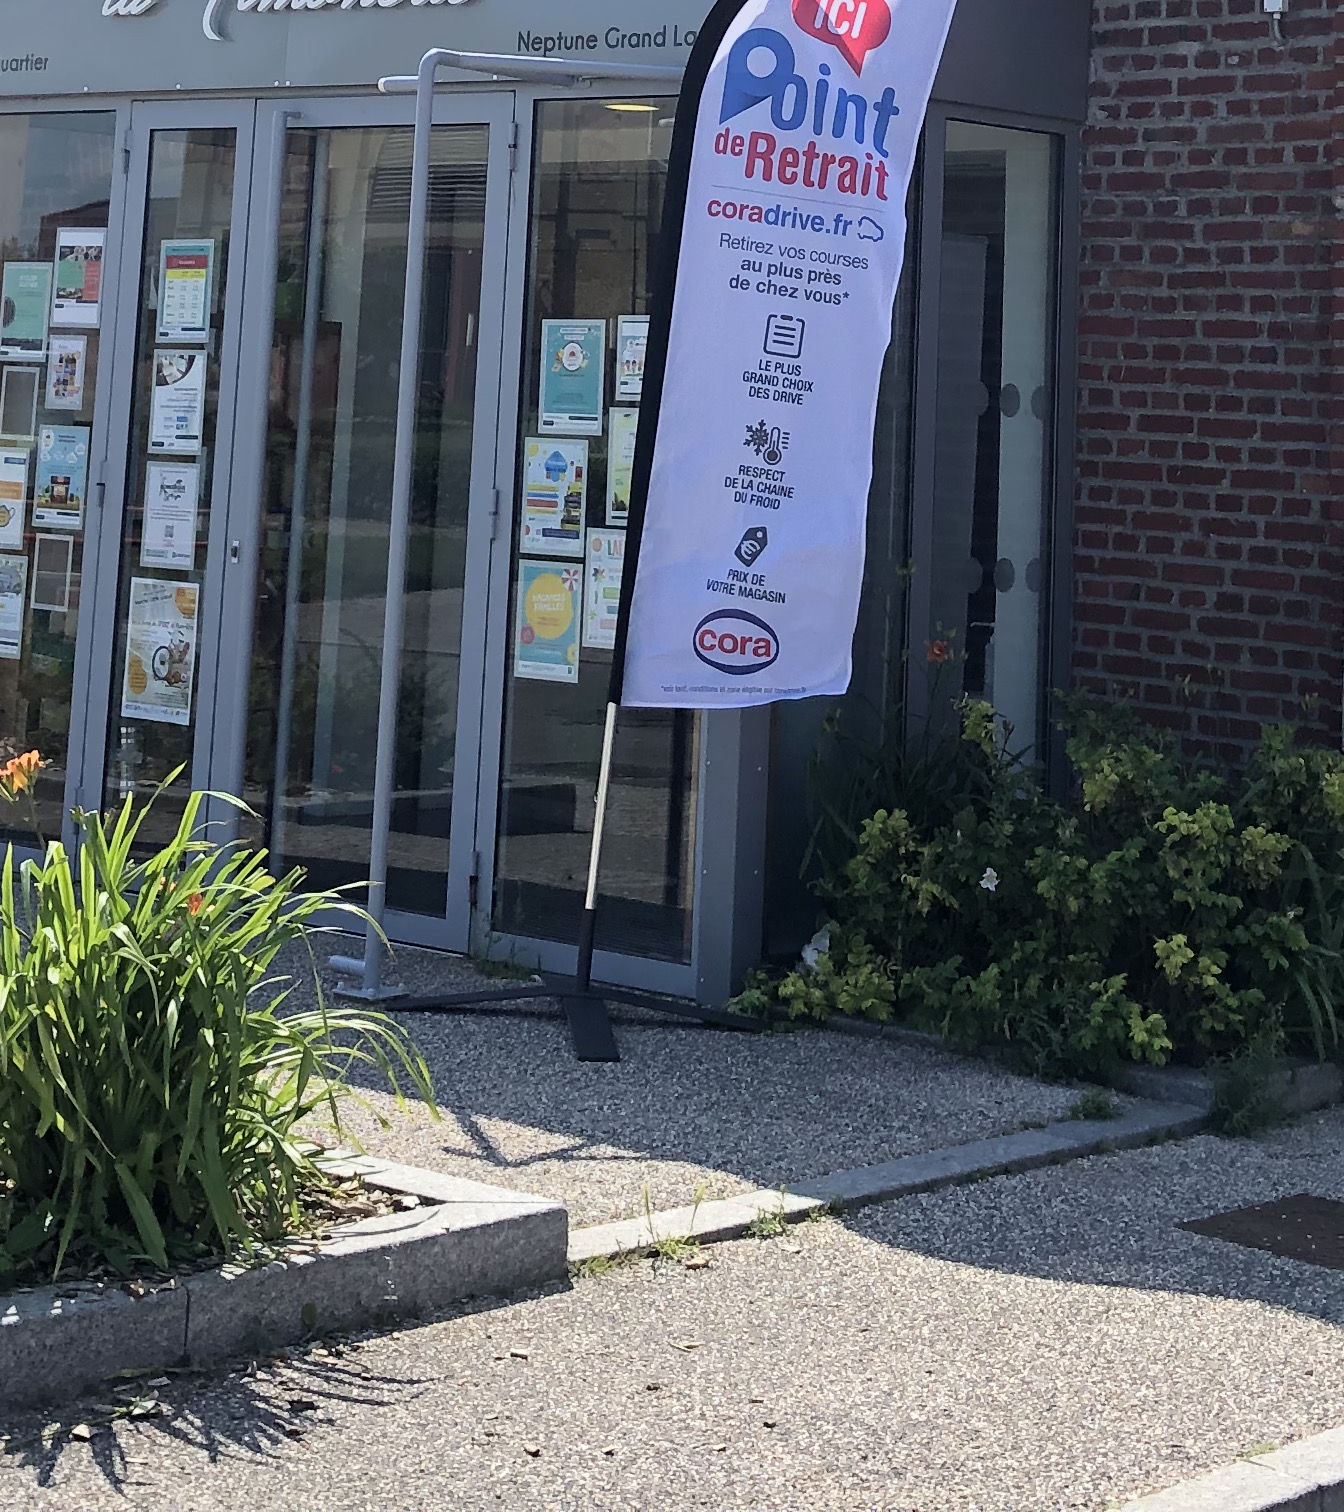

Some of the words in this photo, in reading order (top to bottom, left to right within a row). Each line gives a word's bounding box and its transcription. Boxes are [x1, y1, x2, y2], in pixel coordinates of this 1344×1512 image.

[517, 30, 598, 57] Neptune
[605, 25, 667, 49] Grand
[673, 24, 698, 47] La
[719, 27, 900, 159] Point
[714, 127, 744, 157] de
[744, 131, 890, 201] Retrait
[707, 199, 853, 236] coradrive.fr
[719, 232, 774, 255] Retirez
[778, 245, 806, 260] vos
[809, 250, 869, 270] courses
[740, 259, 762, 273] au
[766, 262, 804, 279] plus
[807, 268, 842, 286] près
[729, 274, 751, 291] de
[756, 279, 799, 299] chez
[758, 359, 772, 372] LE
[774, 361, 802, 377] PLUS
[742, 371, 779, 387] GRAND
[782, 377, 814, 393] CHOIX
[748, 386, 770, 399] DES
[772, 389, 804, 405] DRIVE
[738, 464, 786, 482] RESPECT
[724, 476, 739, 488] DE
[741, 478, 754, 491] LA
[756, 481, 795, 498] CHAINE
[734, 491, 748, 503] DU
[749, 494, 781, 510] FROID
[726, 569, 749, 583] PRIX
[751, 573, 766, 586] DE
[706, 578, 736, 595] VOTRE
[738, 585, 786, 604] MAGASIN
[698, 629, 771, 657] cora
